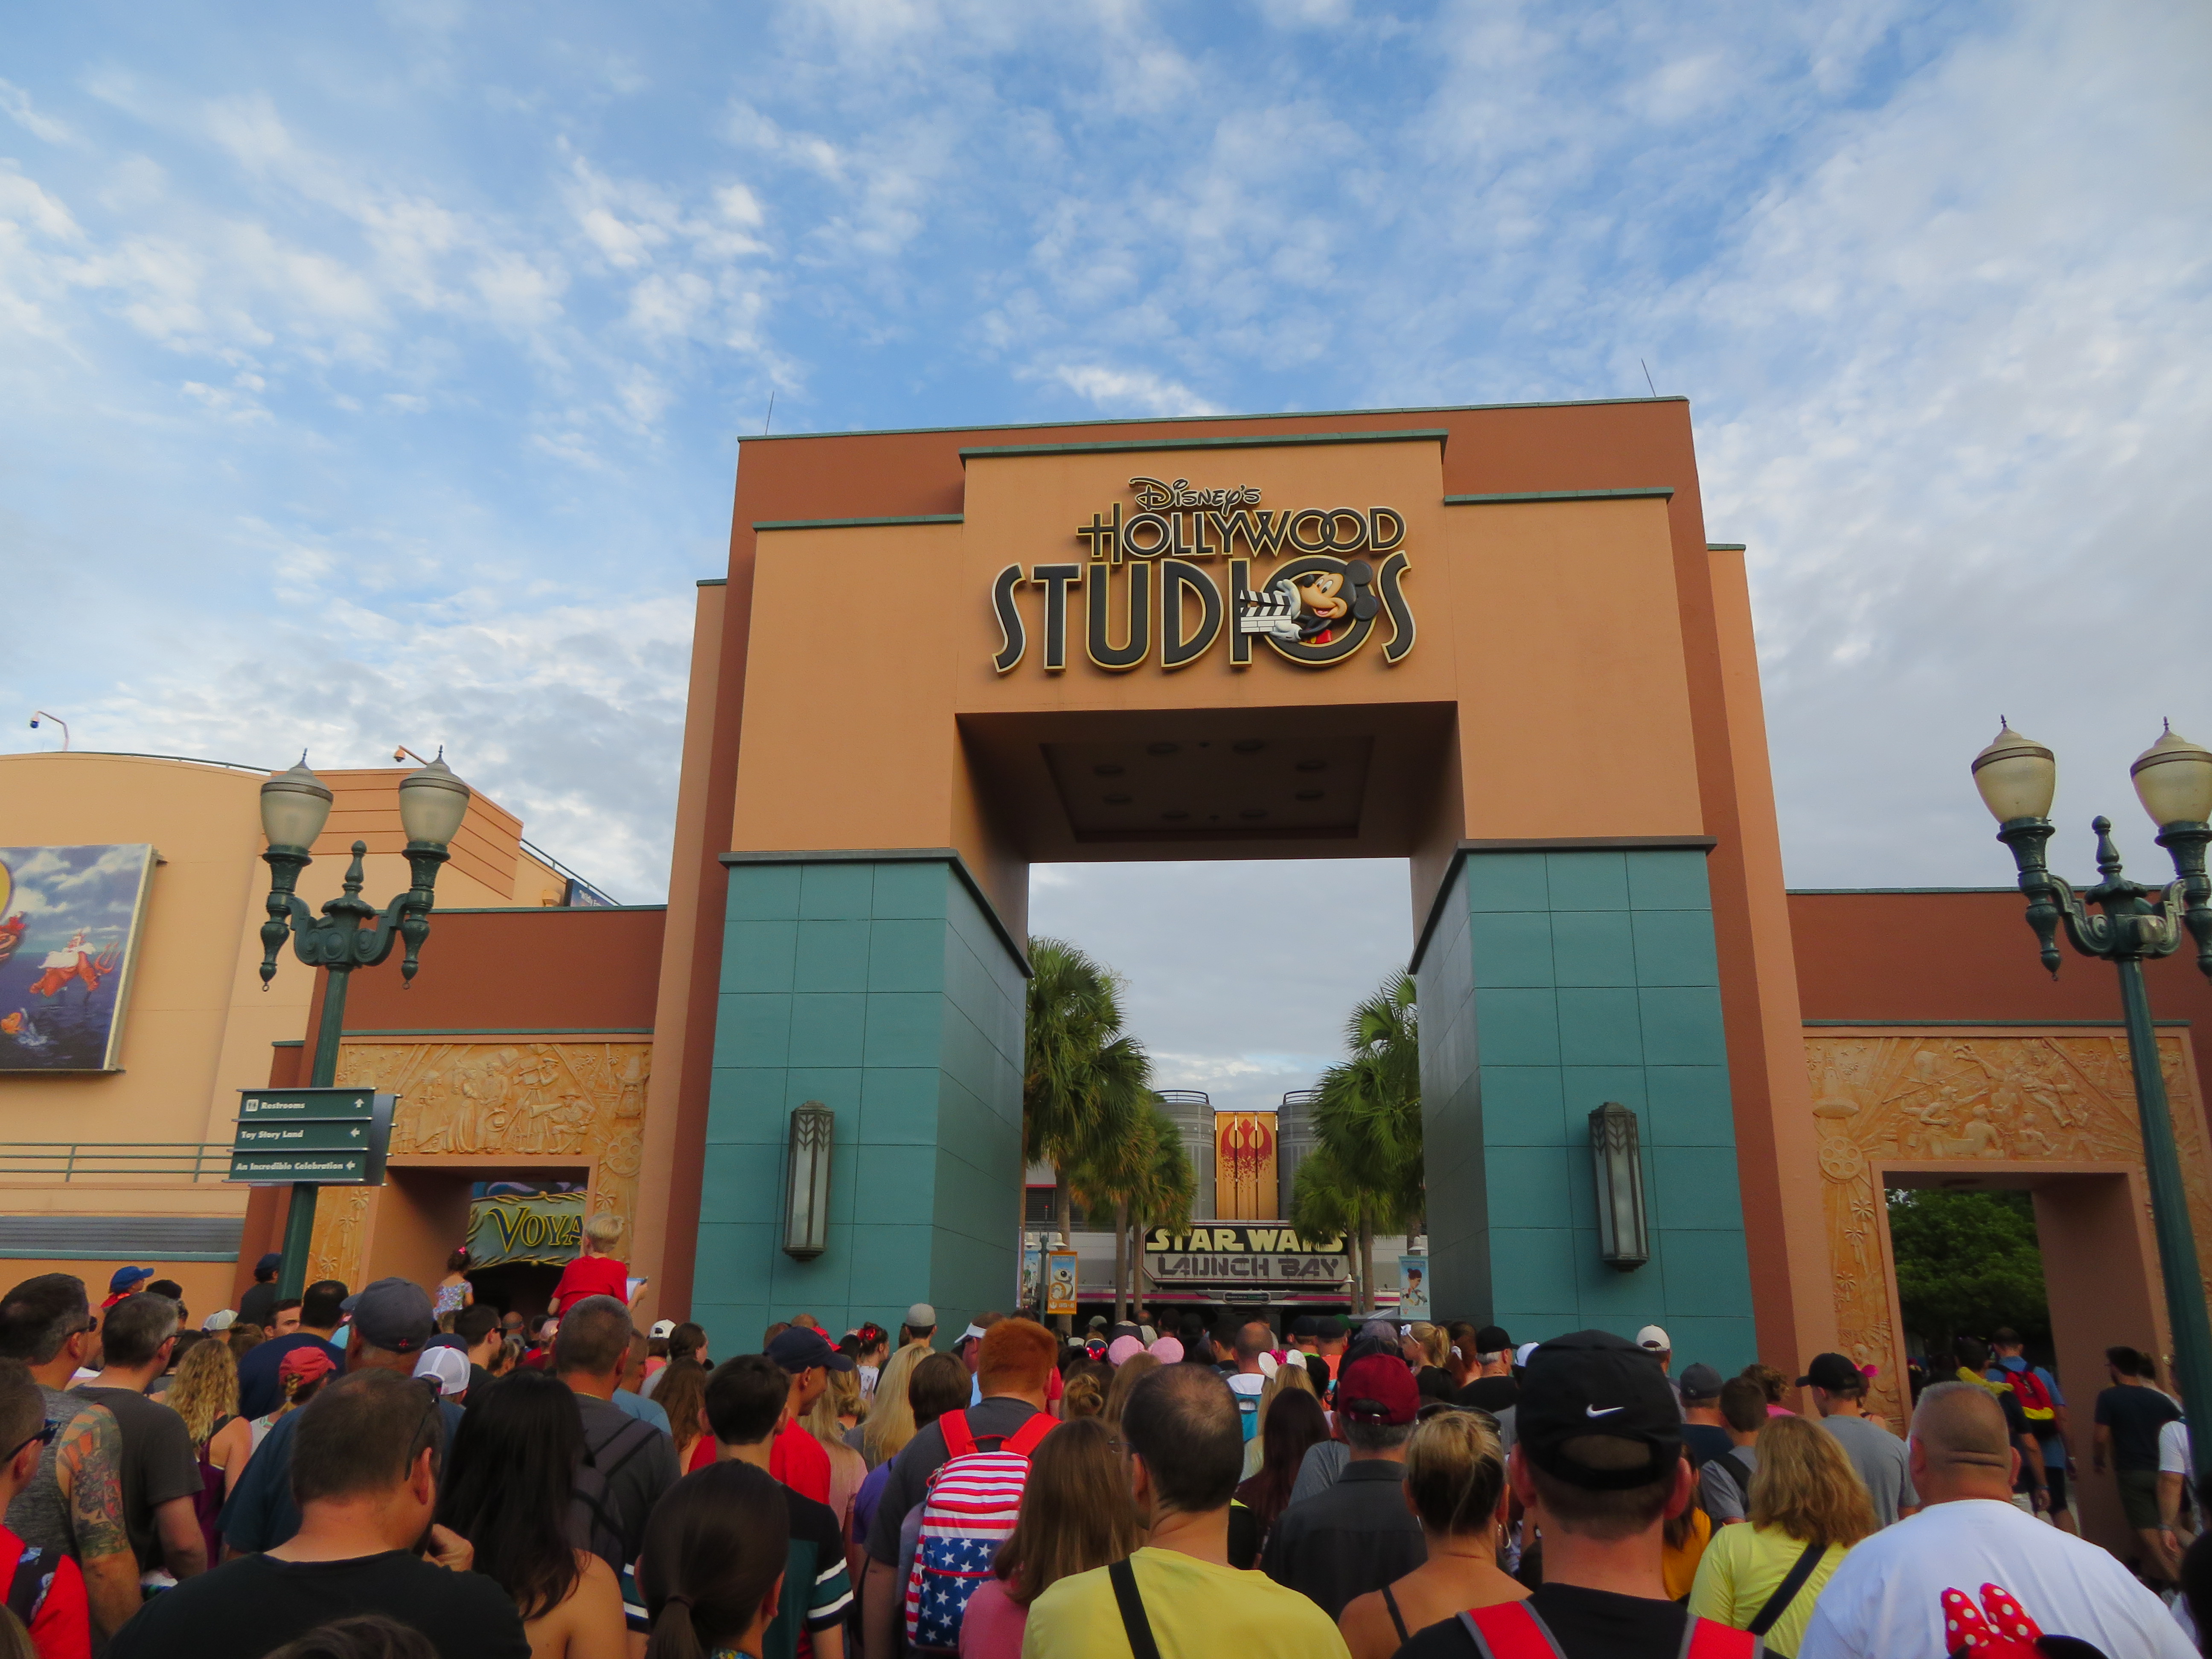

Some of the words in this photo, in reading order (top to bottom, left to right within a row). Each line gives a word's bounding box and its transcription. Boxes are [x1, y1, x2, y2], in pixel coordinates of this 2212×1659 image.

[1076, 502, 1406, 567] HOLLYWOOD
[991, 550, 1416, 675] STUDIOS
[241, 1131, 256, 1140] Toy
[258, 1130, 281, 1140] Story
[250, 1161, 292, 1170] Incredible
[294, 1161, 343, 1170] Celebration
[1146, 1228, 1244, 1252] STAR
[1158, 1257, 1269, 1277] LAUNCH
[1278, 1257, 1339, 1277] BAY
